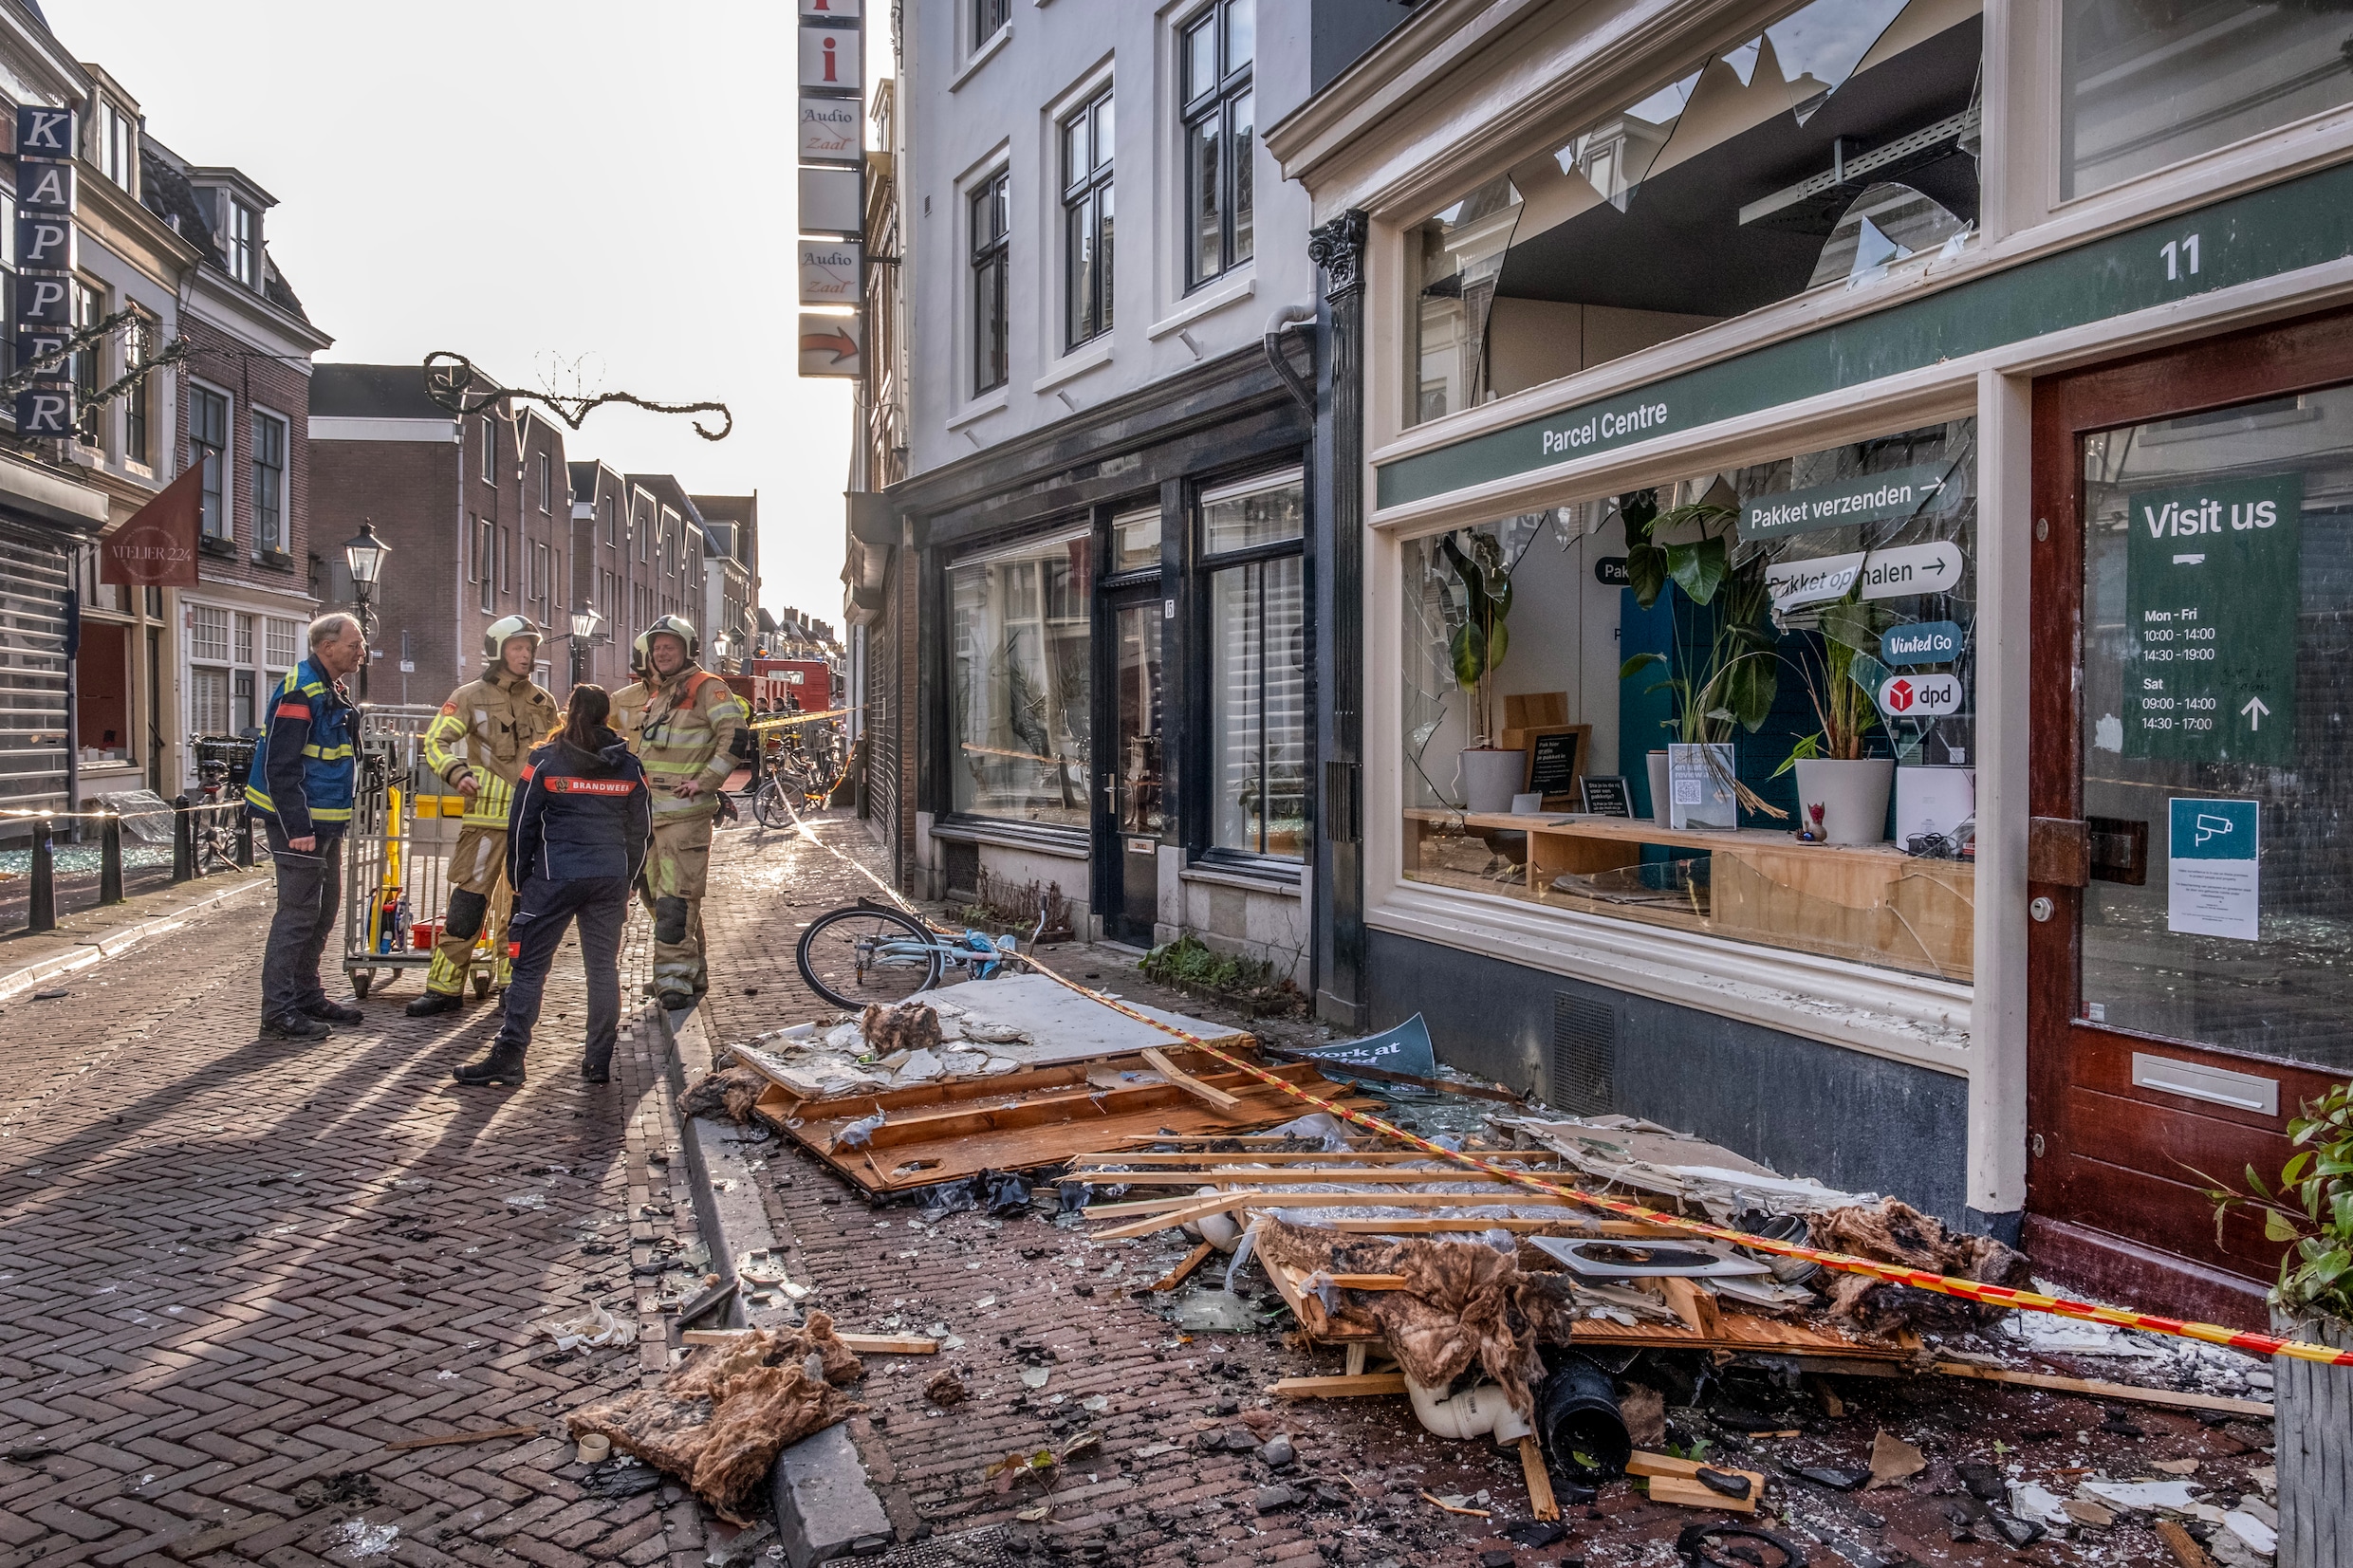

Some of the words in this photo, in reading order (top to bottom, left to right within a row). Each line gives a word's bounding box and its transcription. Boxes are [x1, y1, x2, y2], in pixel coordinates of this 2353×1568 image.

[802, 108, 853, 124] Audio
[806, 137, 854, 151] Zaal
[802, 251, 853, 267] Audio
[2159, 233, 2199, 281] 11
[24, 111, 69, 432] KAPPER
[806, 280, 855, 295] Zaal
[1543, 415, 1598, 455] Parcel
[1601, 402, 1668, 440] Centre
[1751, 500, 1807, 529] Pakket
[1812, 484, 1912, 519] verzenden
[2144, 498, 2223, 539] Visit
[2231, 499, 2277, 530] us
[112, 545, 165, 560] ATELIER
[167, 547, 192, 562] 224
[1770, 571, 1827, 598] Pakket
[2144, 610, 2172, 622] Mon
[2181, 607, 2197, 620] Fri
[2144, 629, 2174, 642] 10:00
[2184, 627, 2215, 640] 14:00
[1890, 635, 1932, 655] Vinted
[1934, 635, 1953, 652] Go
[2143, 649, 2174, 662] 14:30
[2184, 647, 2215, 660] 19:00
[2143, 677, 2164, 691] Sat
[1919, 684, 1951, 709] dpd
[2142, 697, 2175, 710] 09:00
[2185, 696, 2216, 710] 14:00
[2142, 717, 2173, 729] 14:30
[2182, 717, 2213, 730] 17:00
[1300, 1048, 1370, 1059] Work
[1374, 1042, 1401, 1056] at
